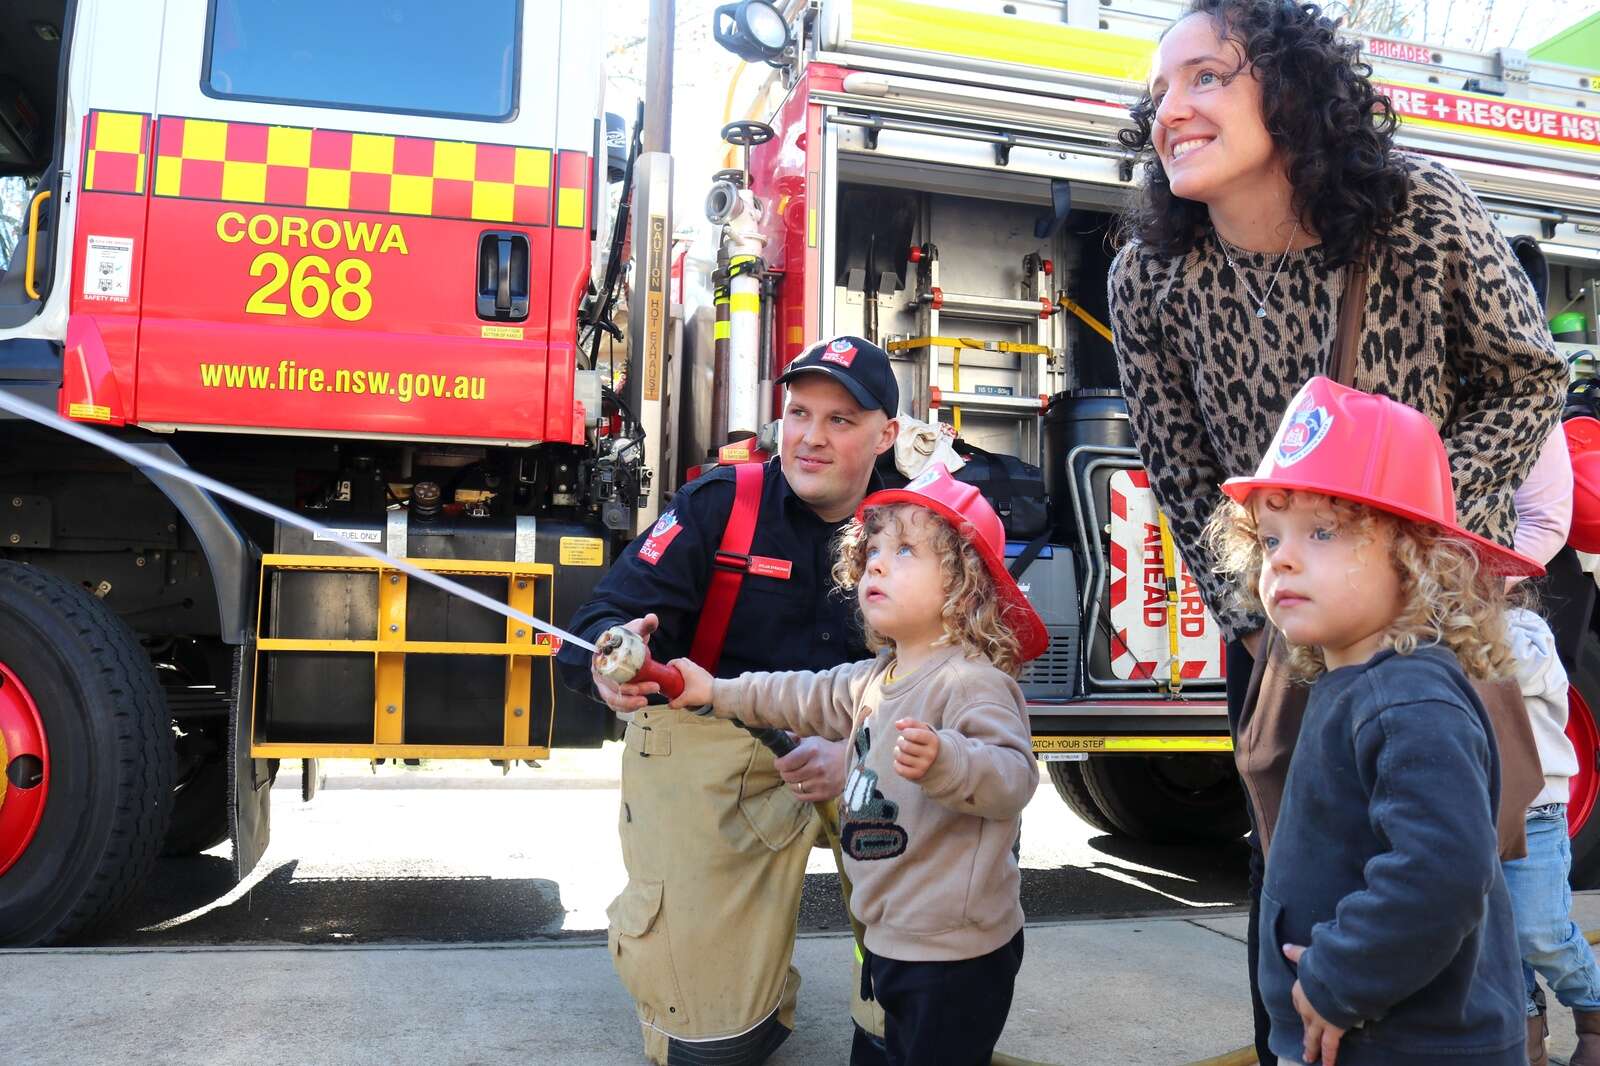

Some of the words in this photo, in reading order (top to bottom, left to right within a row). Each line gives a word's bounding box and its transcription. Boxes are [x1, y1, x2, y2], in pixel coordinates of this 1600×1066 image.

[1370, 39, 1430, 64] BRIGADES
[1455, 98, 1558, 136] RESCUE
[216, 211, 409, 255] COROWA
[651, 222, 663, 288] CAUTION
[84, 294, 109, 302] SAFETY
[245, 251, 373, 322] 268
[650, 299, 659, 328] HOT
[200, 360, 486, 403] www.fire.nsw.gov.au
[647, 332, 657, 398] EXHAUST
[342, 532, 358, 540] FUEL
[360, 532, 378, 540] ONLY
[640, 546, 660, 560] SCUE
[1144, 522, 1168, 628] AHEAD
[1180, 560, 1205, 638] ARD
[1032, 740, 1054, 748] ATCH
[1056, 740, 1080, 748] YOUR
[1082, 740, 1104, 748] STEP
